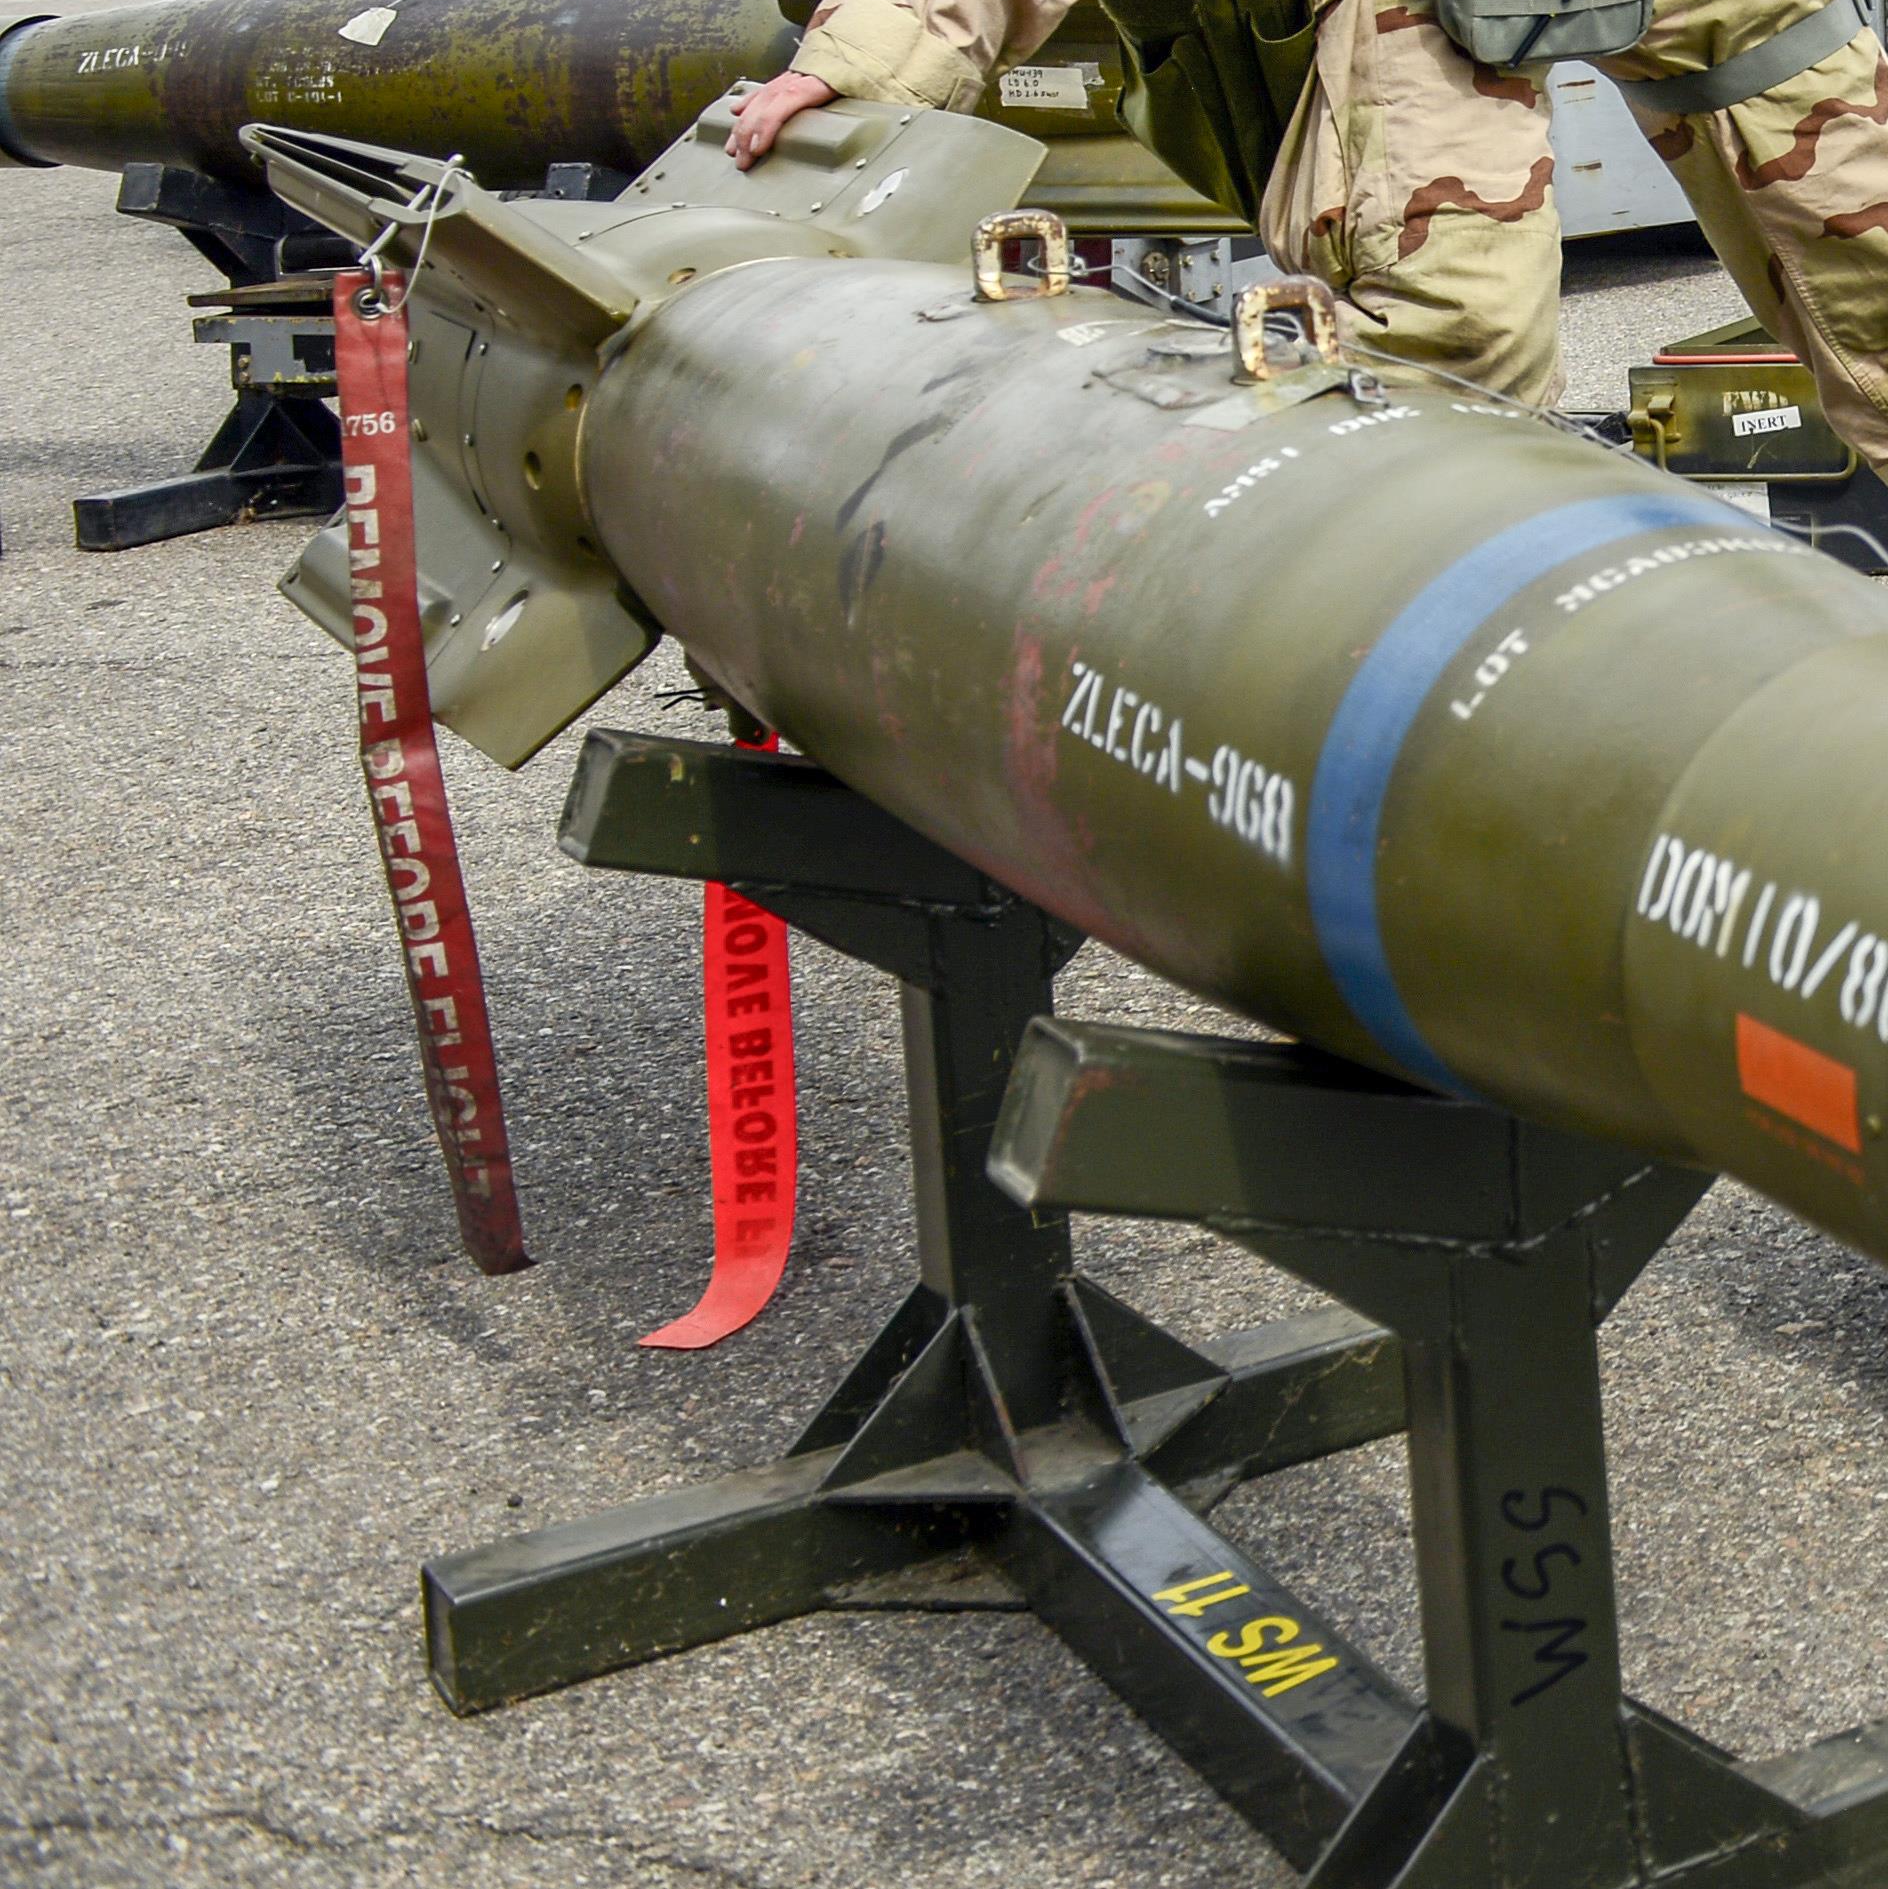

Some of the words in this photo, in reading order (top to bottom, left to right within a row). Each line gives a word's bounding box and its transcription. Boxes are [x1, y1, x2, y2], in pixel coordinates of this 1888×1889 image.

[1741, 414, 1788, 432] INERT
[1450, 626, 1531, 721] LOT
[1150, 1568, 1251, 1617] 11
[1205, 1614, 1340, 1699] WS
